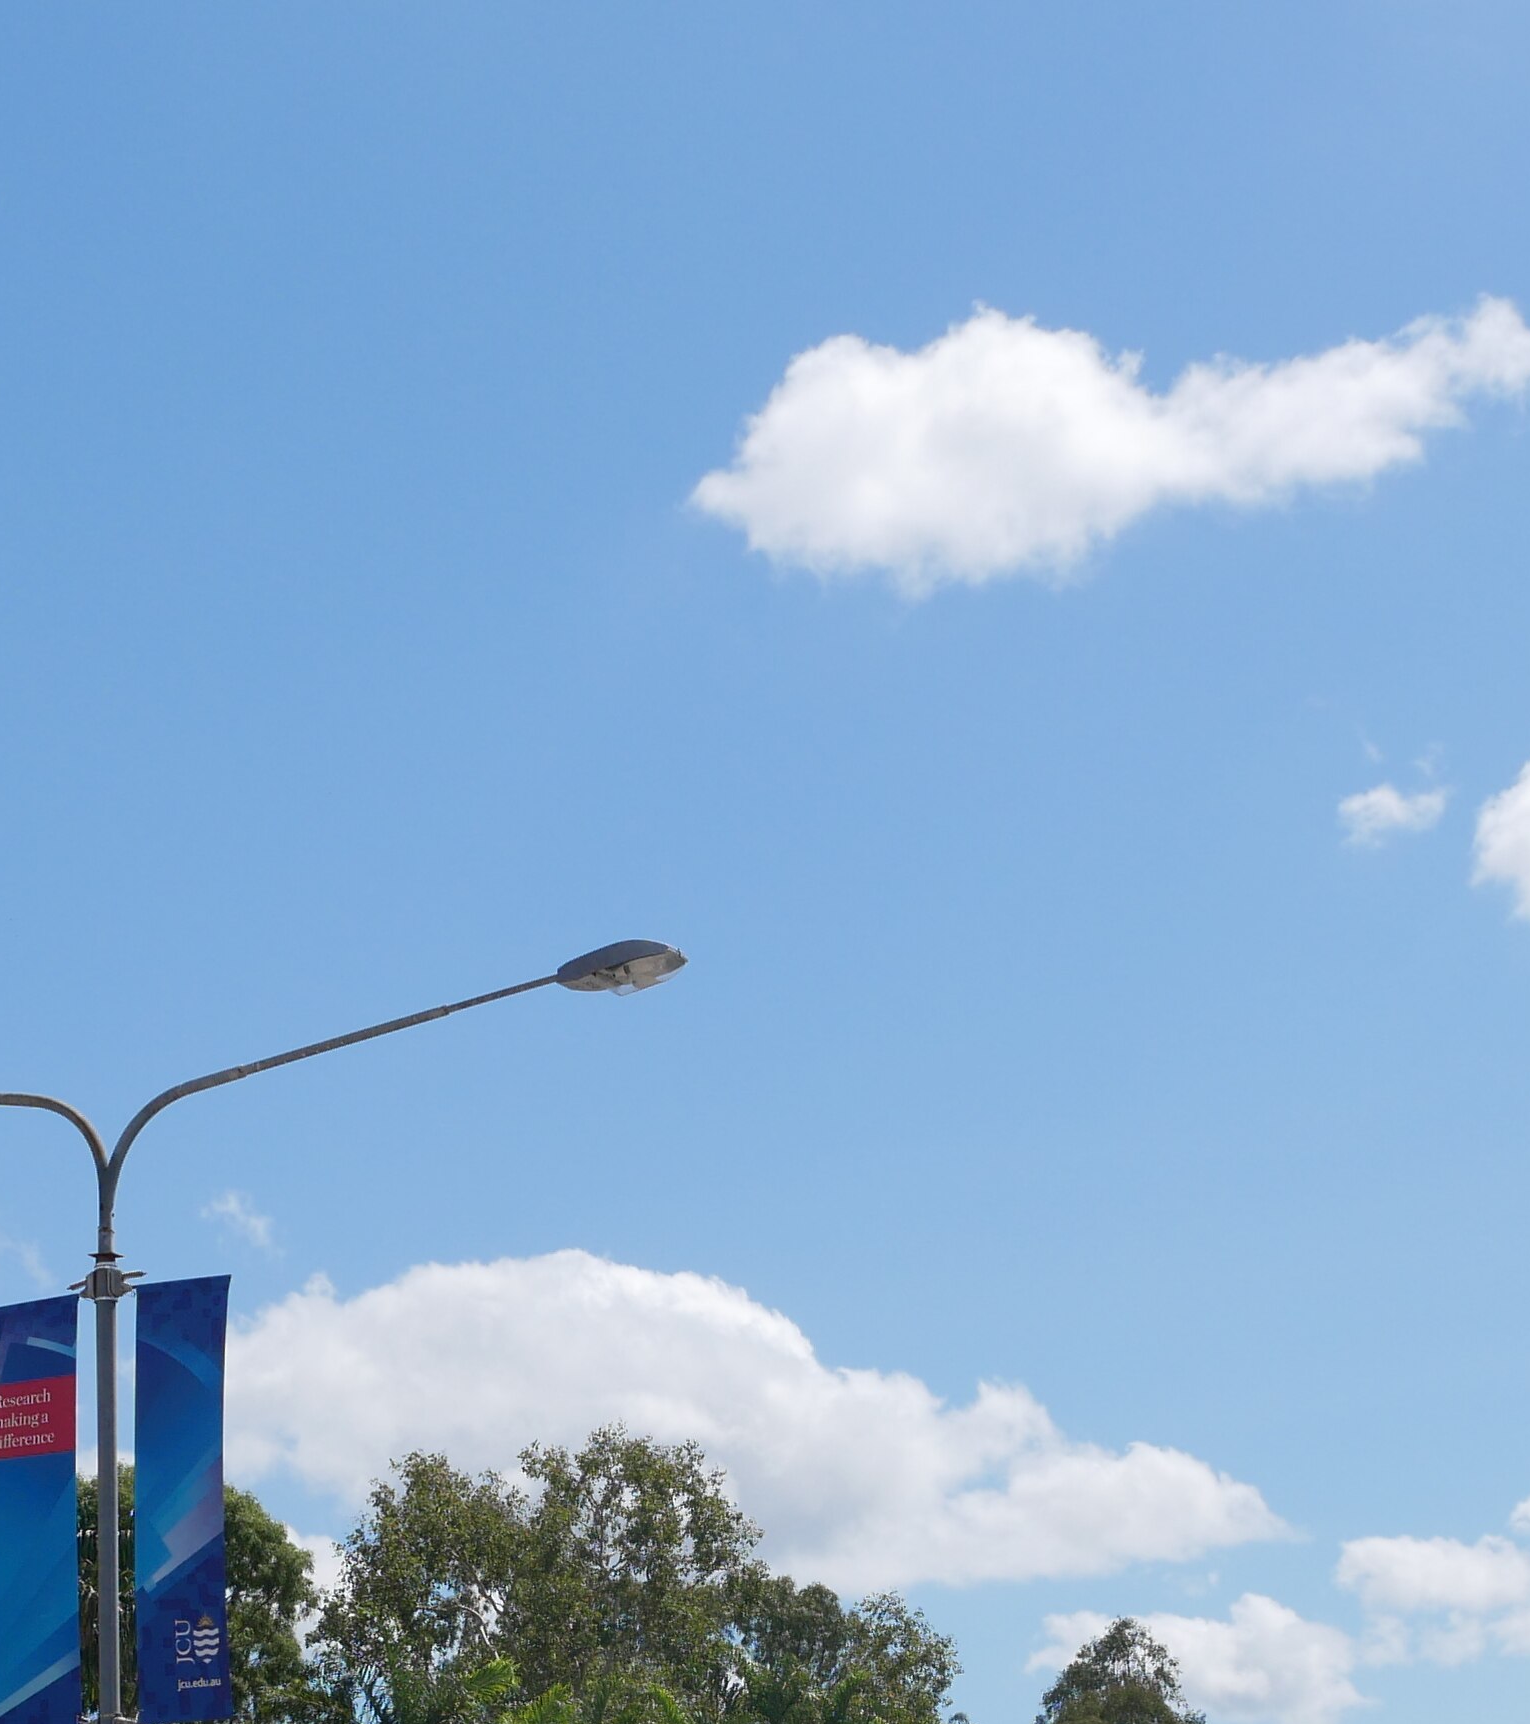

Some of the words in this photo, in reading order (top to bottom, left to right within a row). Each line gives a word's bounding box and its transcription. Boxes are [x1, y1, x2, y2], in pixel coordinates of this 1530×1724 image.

[41, 1412, 49, 1424] a
[174, 1619, 196, 1665] JCU
[177, 1677, 221, 1692] jcu.edu.au
